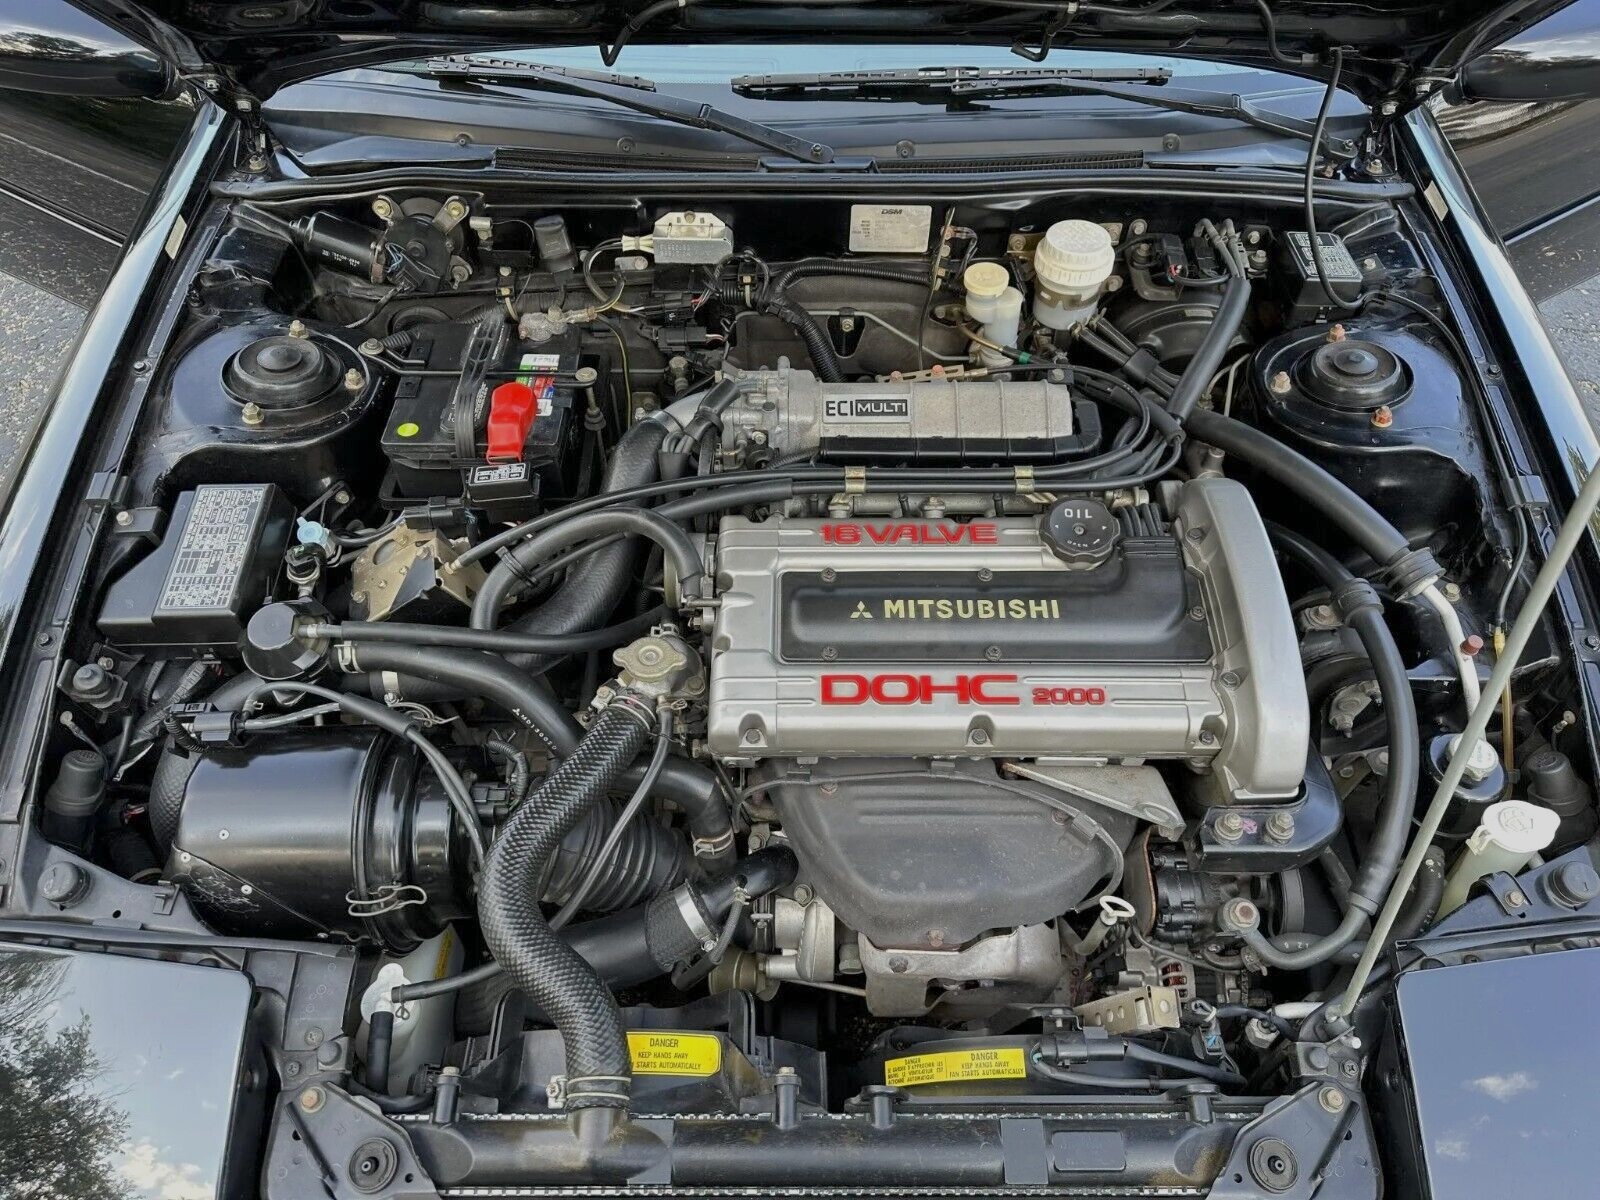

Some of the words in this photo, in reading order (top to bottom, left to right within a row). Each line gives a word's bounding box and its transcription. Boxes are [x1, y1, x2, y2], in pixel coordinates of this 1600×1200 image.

[825, 400, 854, 417] ECI
[856, 402, 907, 414] MULTI
[1064, 508, 1093, 519] OIL
[883, 599, 1061, 619] MITSUBISHI
[820, 674, 1021, 706] DOHC
[1031, 687, 1106, 706] 2000
[649, 1037, 680, 1048] DANGER
[637, 1051, 652, 1059] KEEP
[653, 1051, 672, 1060] HANDS
[673, 1052, 689, 1060] AWAY
[970, 1052, 999, 1061] DANGER
[636, 1061, 657, 1069] STARTS
[658, 1062, 702, 1070] AUTOMATICALLY
[975, 1061, 993, 1069] HANDS
[961, 1069, 980, 1078] STARTS
[981, 1068, 1024, 1076] AUTOMATICALLY
